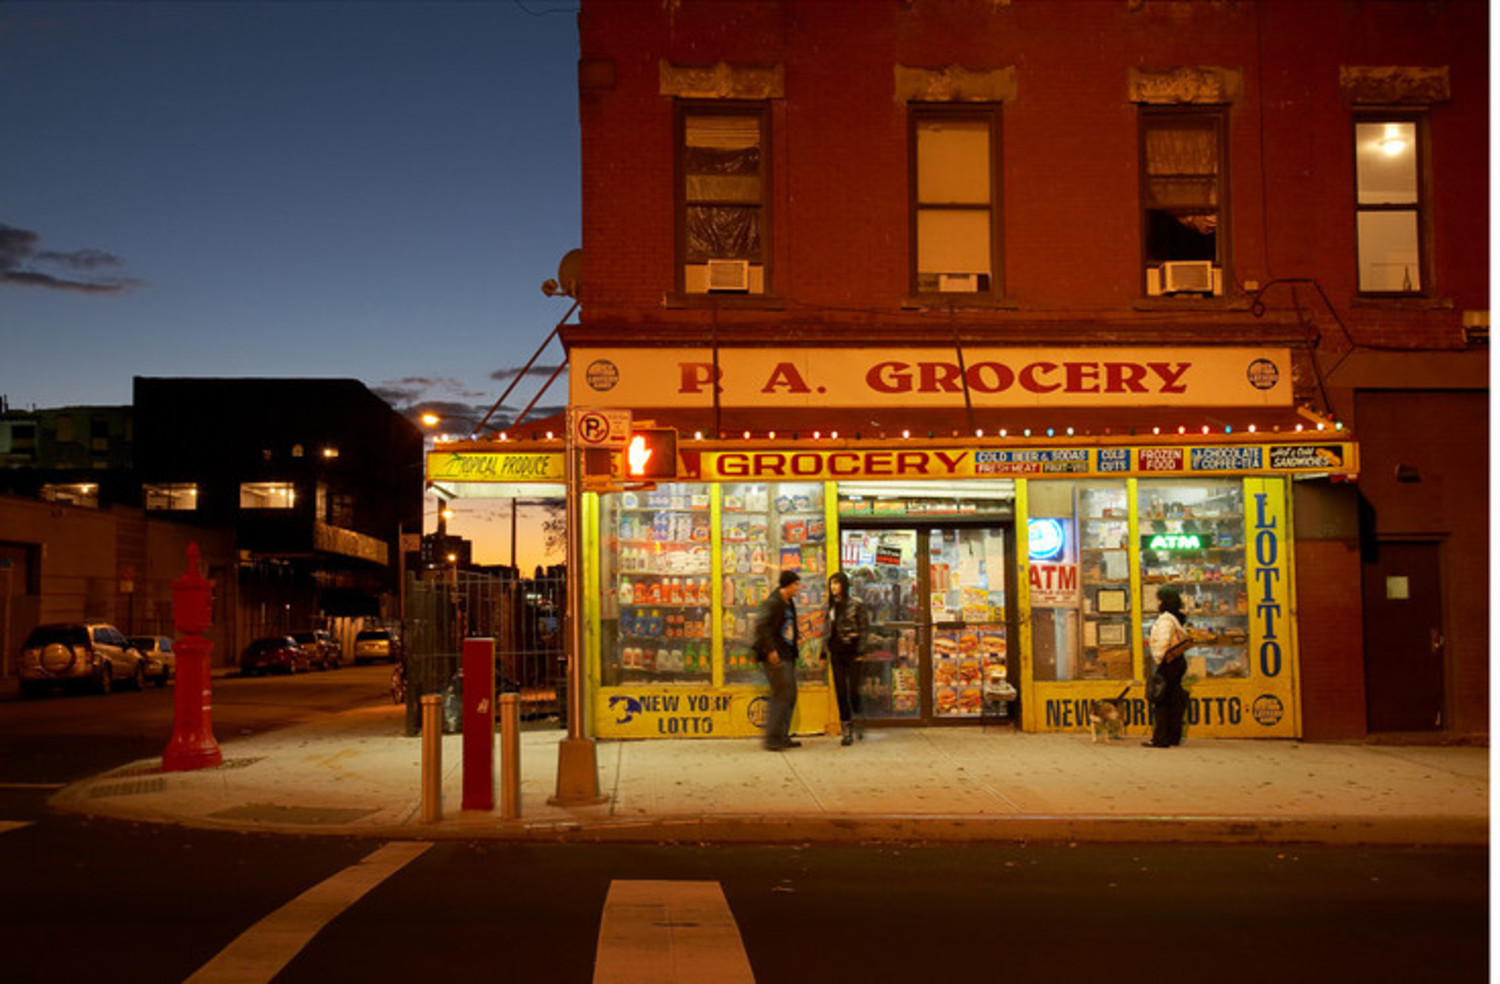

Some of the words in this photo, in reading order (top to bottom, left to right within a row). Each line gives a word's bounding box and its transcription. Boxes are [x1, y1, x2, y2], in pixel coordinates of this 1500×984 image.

[761, 361, 826, 394] A.
[865, 361, 1193, 395] GROCERY
[978, 452, 1007, 463] COLD
[1052, 449, 1086, 462] SODAS
[1101, 449, 1126, 459] COLD
[1140, 450, 1182, 459] FROZEN
[500, 455, 550, 475] PRODUCE
[716, 451, 969, 477] GROCERY
[1011, 462, 1040, 473] MEAT
[1146, 459, 1176, 470] FOOD
[1150, 535, 1201, 549] ATM
[1029, 565, 1077, 590] ATM
[1253, 493, 1282, 677] LOTTO
[639, 695, 680, 712] NEW
[1046, 699, 1094, 726] NEW
[1187, 696, 1241, 725] OTTO
[658, 716, 713, 734] LOTTO
